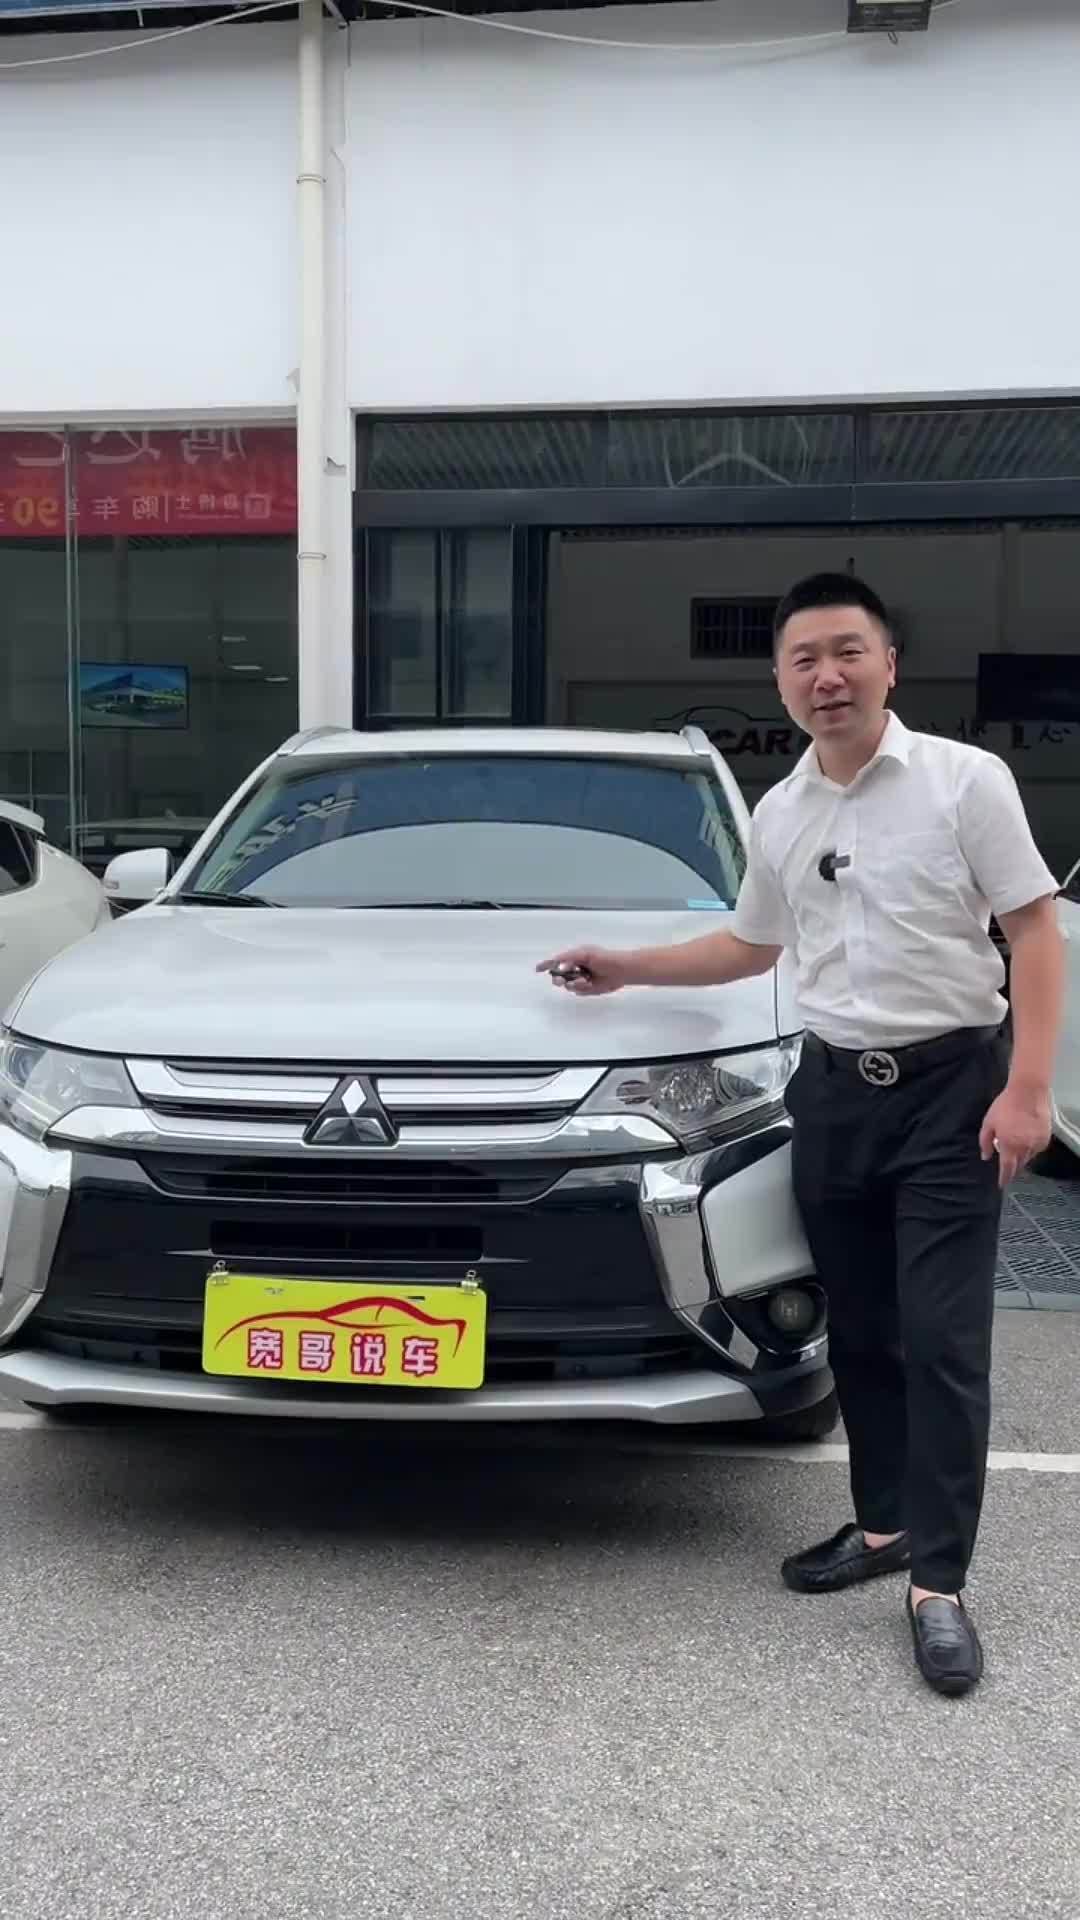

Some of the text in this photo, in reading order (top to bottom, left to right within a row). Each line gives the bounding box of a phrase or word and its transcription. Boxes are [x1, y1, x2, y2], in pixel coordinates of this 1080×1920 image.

[704, 728, 792, 755] CAR
[248, 1327, 438, 1377] 宽哥说车
